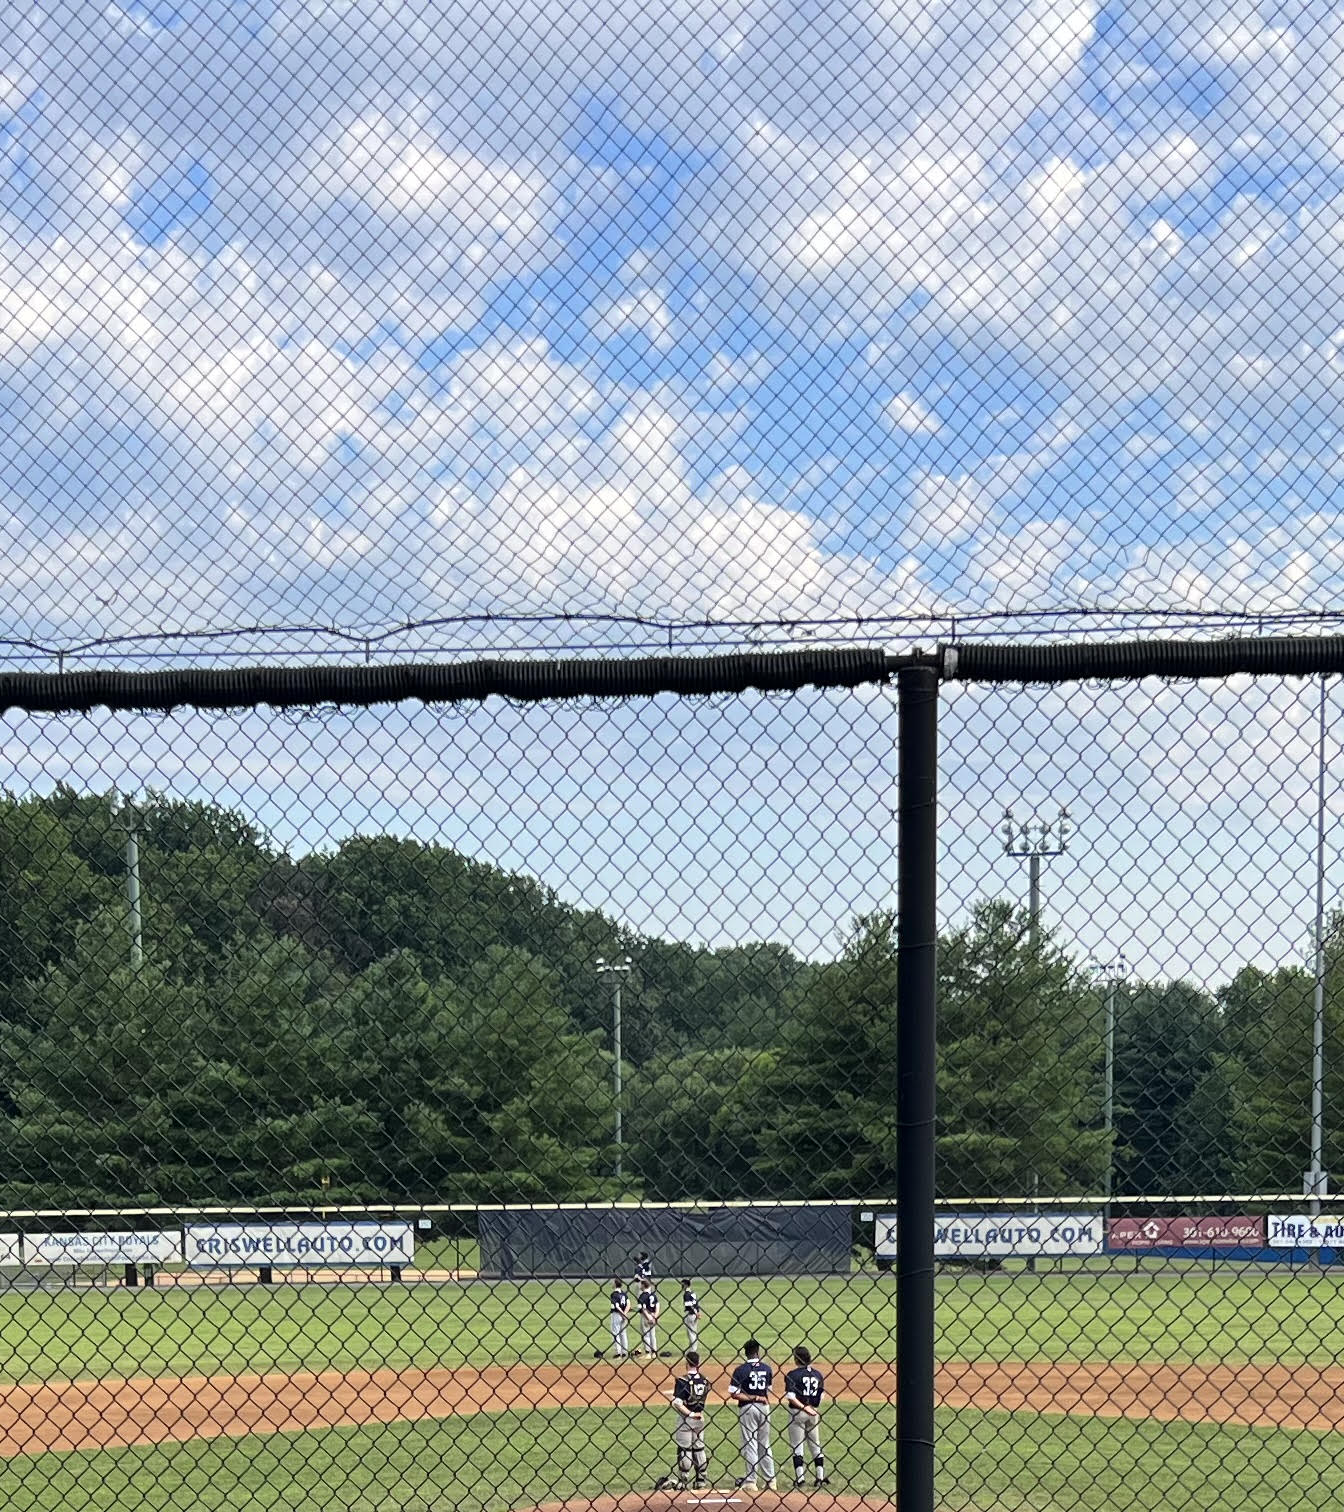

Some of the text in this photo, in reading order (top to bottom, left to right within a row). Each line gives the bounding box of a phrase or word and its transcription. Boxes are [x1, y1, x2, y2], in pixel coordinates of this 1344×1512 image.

[886, 1228, 1093, 1244] CWELLAUTOCOM
[1272, 1222, 1305, 1238] TIRE
[1310, 1225, 1320, 1238] &
[44, 1236, 89, 1247] KANSAS
[92, 1236, 114, 1246] CITY
[196, 1235, 404, 1255] CRISWELLAUTO.COM
[748, 1371, 767, 1390] 35
